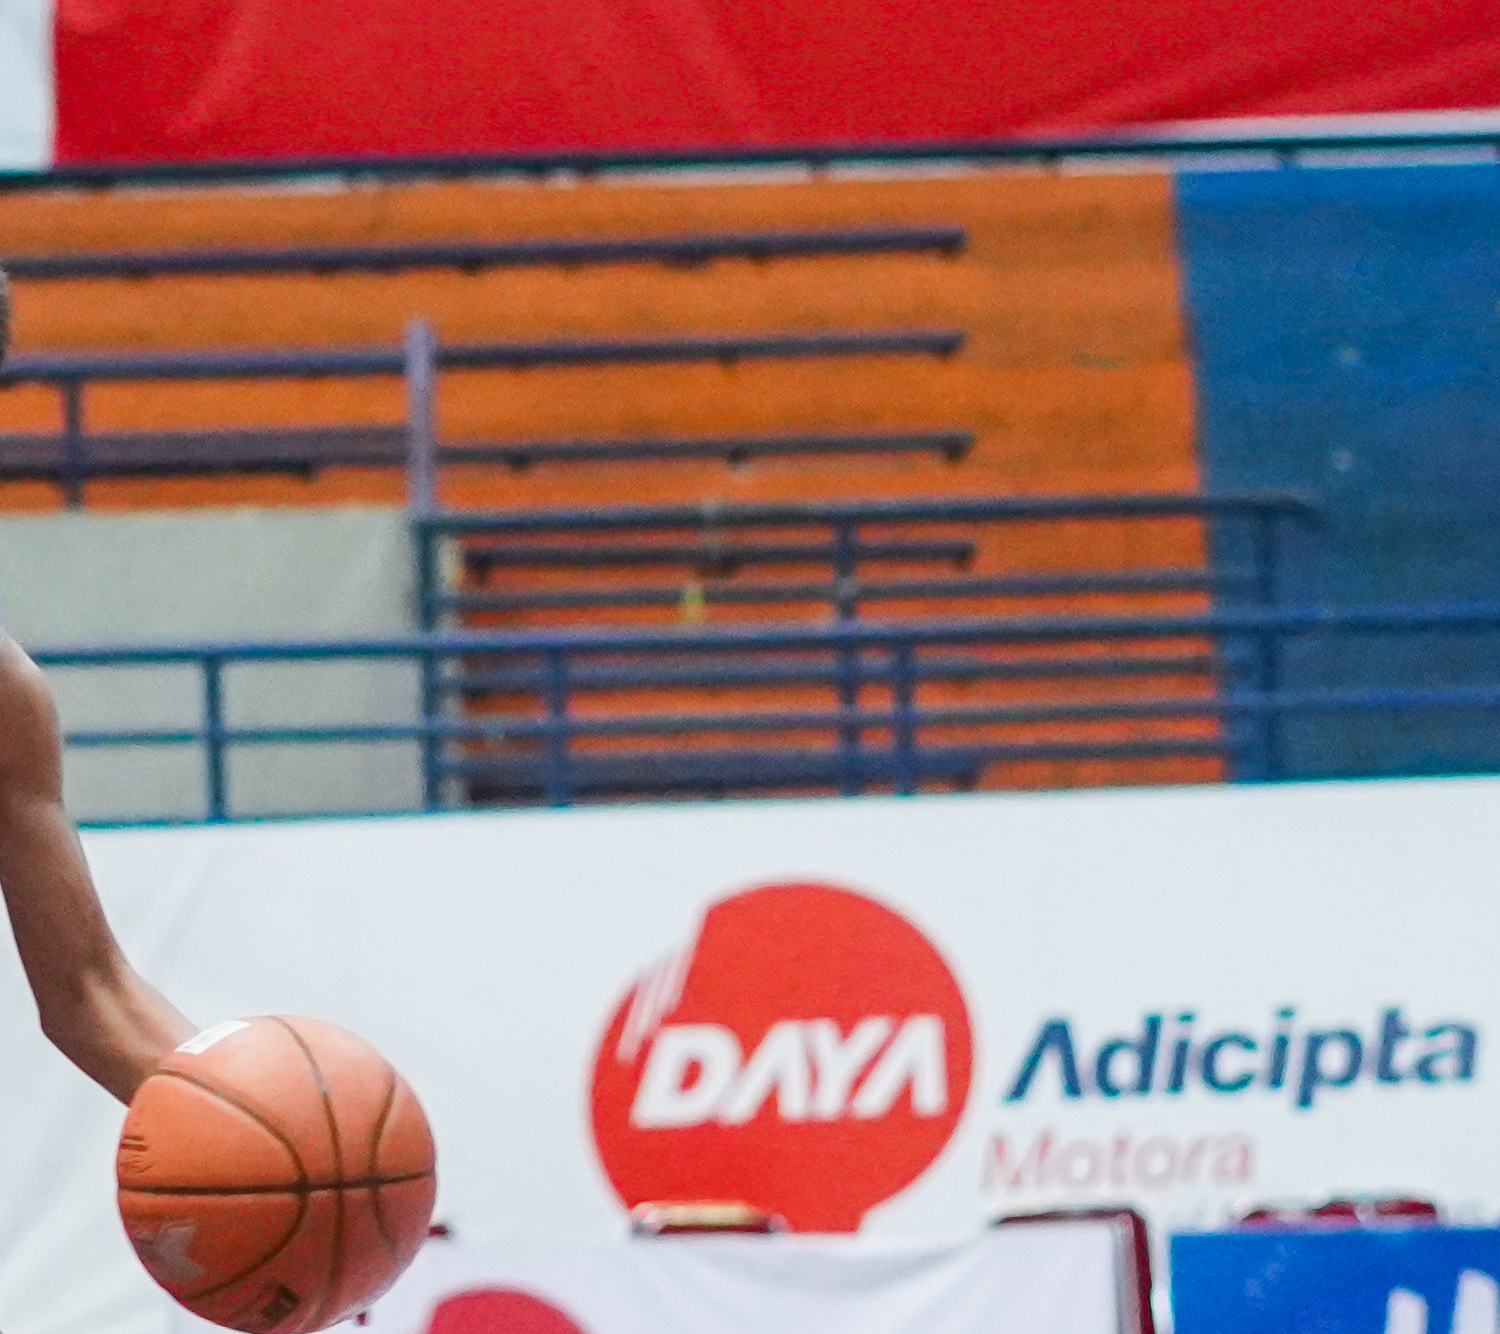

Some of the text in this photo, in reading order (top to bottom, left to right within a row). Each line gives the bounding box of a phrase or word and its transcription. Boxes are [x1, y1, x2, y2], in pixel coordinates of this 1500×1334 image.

[629, 1005, 1482, 1128] DAYA Adicipta
[980, 1127, 1258, 1191] Motora
